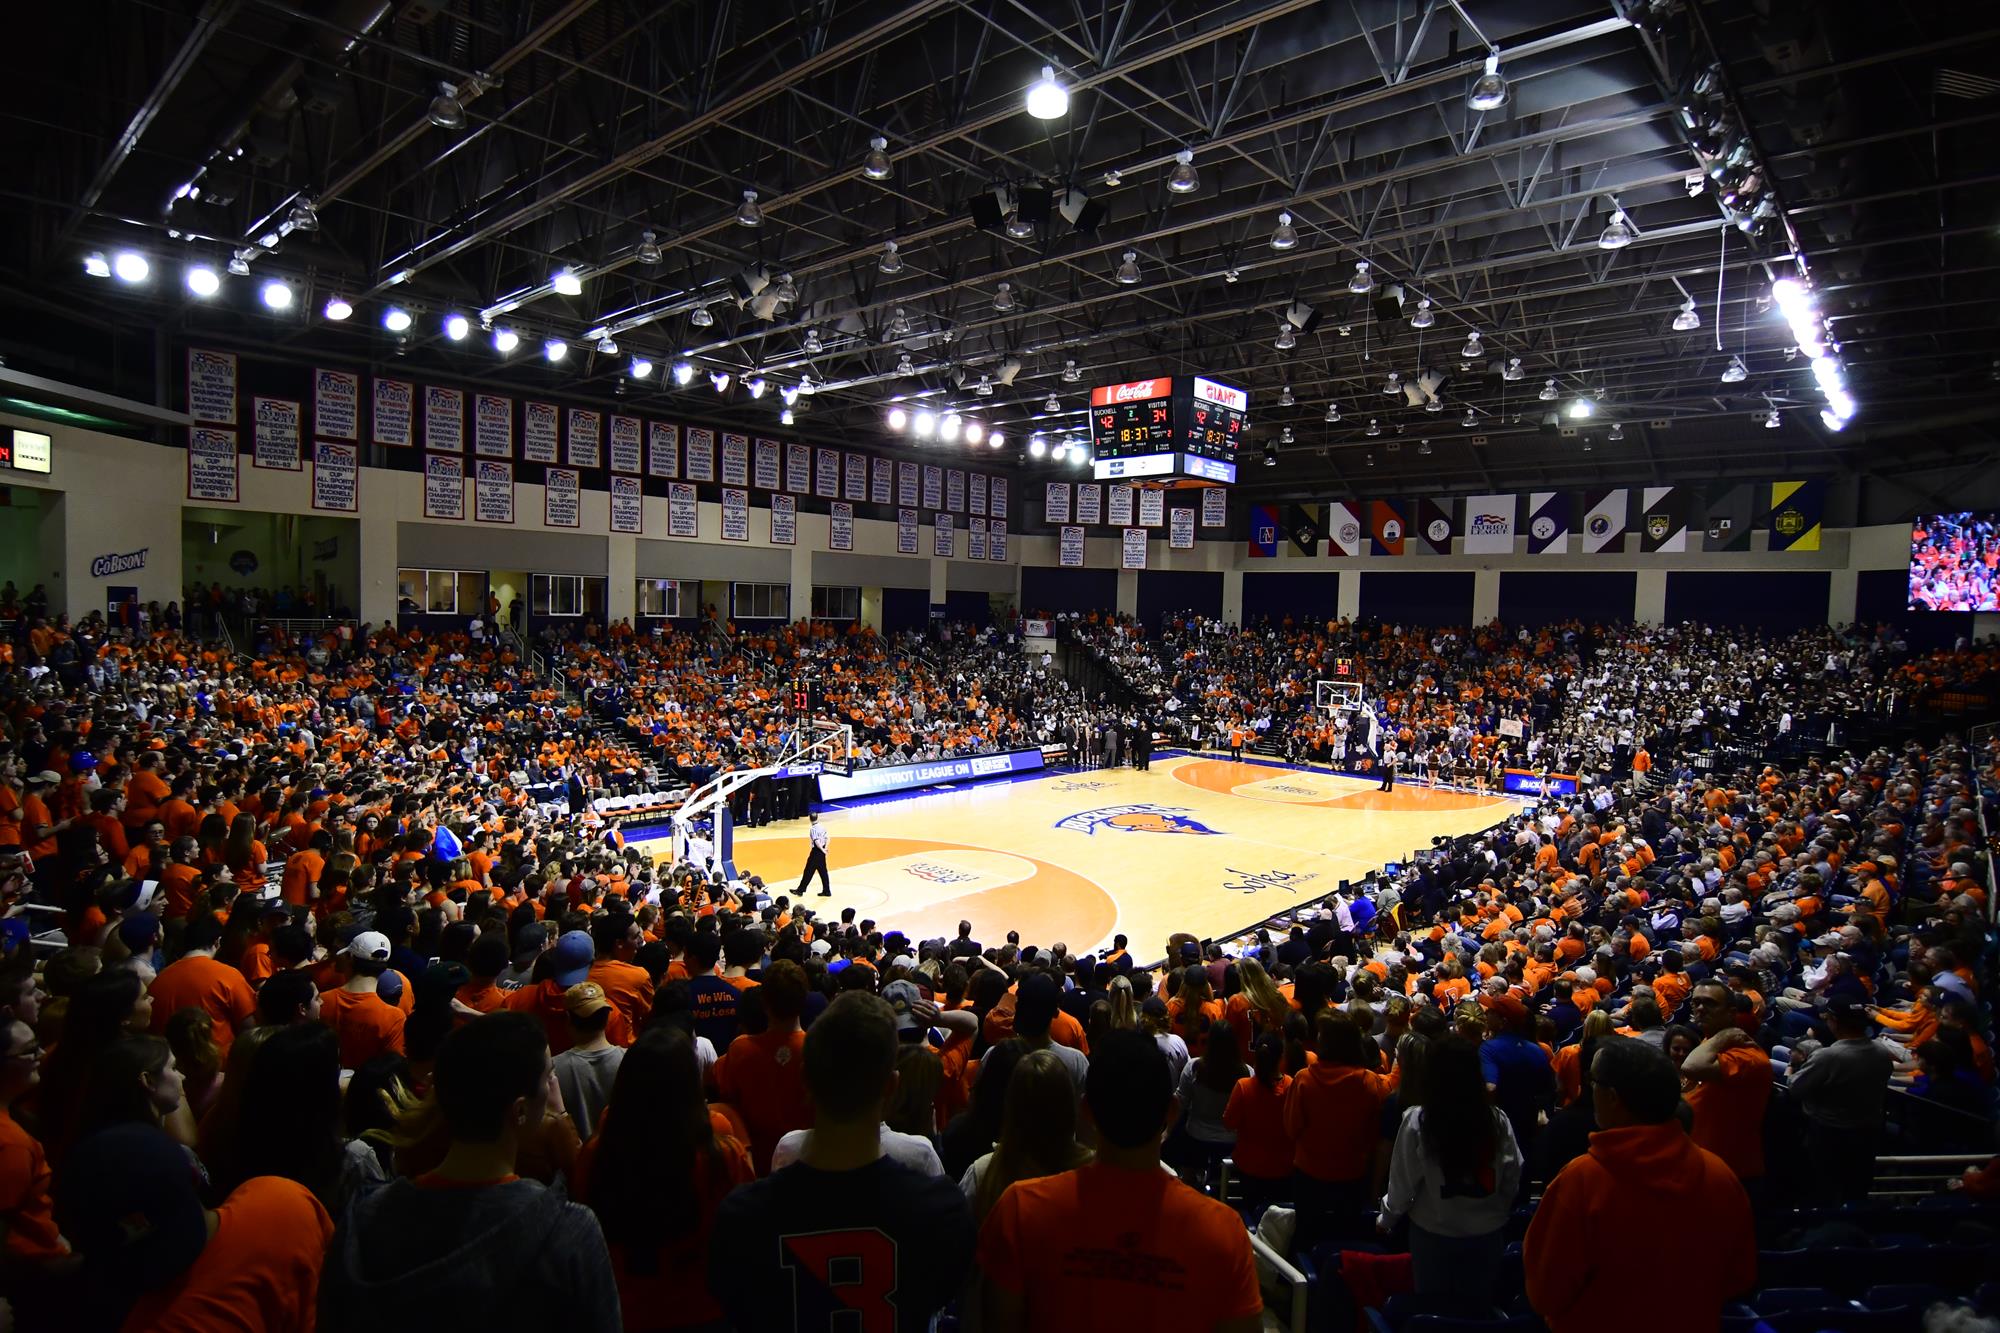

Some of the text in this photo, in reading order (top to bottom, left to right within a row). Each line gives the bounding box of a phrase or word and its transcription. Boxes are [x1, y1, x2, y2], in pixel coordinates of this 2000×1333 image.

[1117, 381, 1155, 400] Coca-Cola
[1207, 385, 1236, 405] GIANT
[1094, 407, 1117, 417] BUCKNELL
[1152, 409, 1166, 423] 34
[1100, 415, 1114, 429] 42
[257, 433, 298, 443] ALL SPORTS
[1121, 427, 1148, 442] 18:37
[257, 441, 297, 449] CHAMPIONS
[260, 447, 296, 456] BUCKNELL
[257, 453, 297, 462] UNIVERSITY
[207, 465, 235, 473] SPORTS
[192, 470, 235, 479] CHAMPIONS
[195, 477, 232, 486] BUCKNELL
[193, 484, 233, 492] UNIVERSITY
[317, 483, 354, 491] CHAMPIONS
[319, 489, 352, 497] BUCKNELL
[317, 495, 353, 503] UNIVERSITY
[1337, 665, 1348, 674] 30
[788, 764, 821, 775] GEICO
[872, 763, 969, 786] PATRIOT LEAGUE ON
[1520, 780, 1560, 789] BUCKLL
[697, 993, 712, 1005] We
[691, 1007, 736, 1019] You Lose
